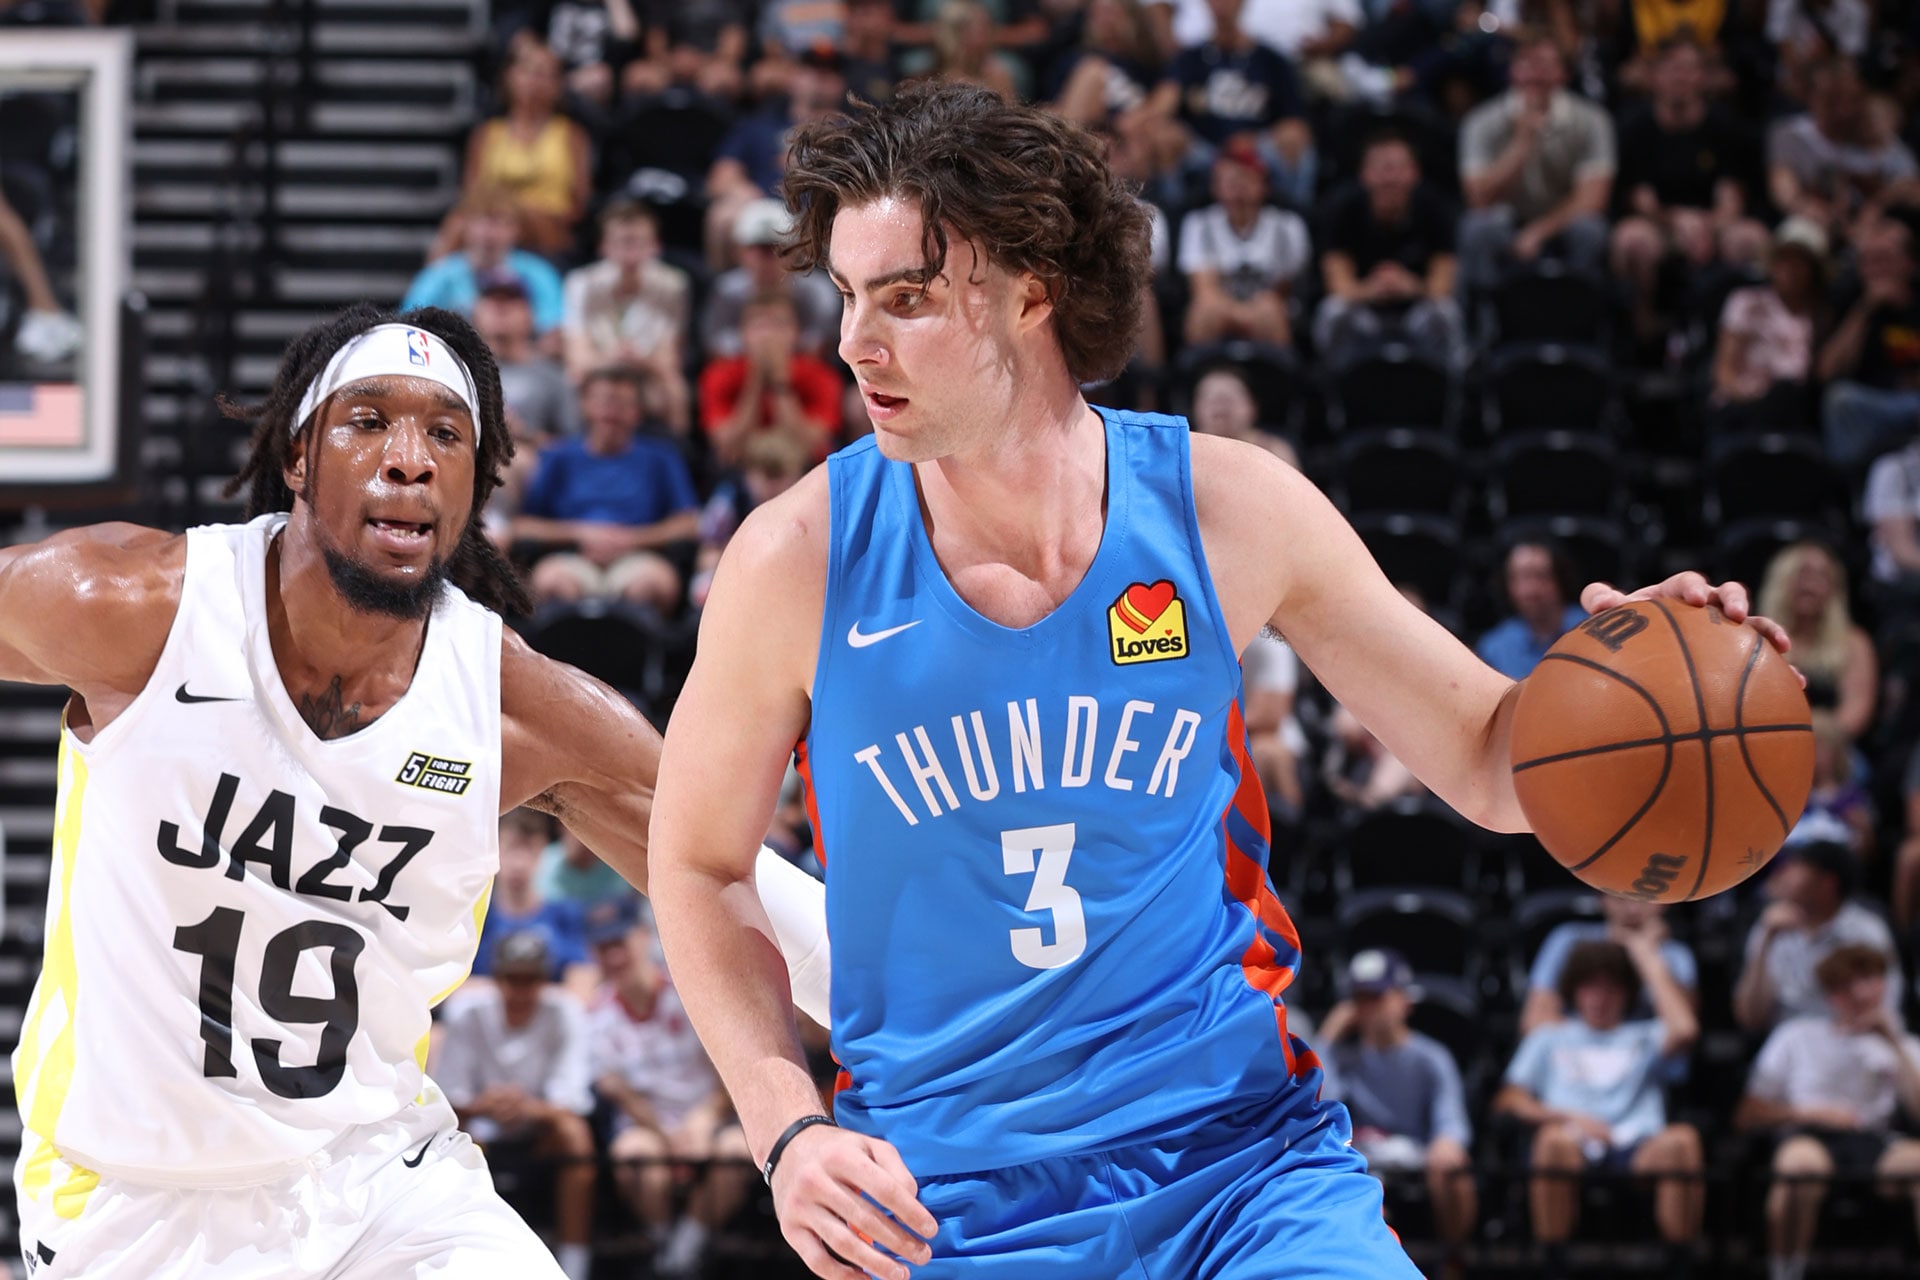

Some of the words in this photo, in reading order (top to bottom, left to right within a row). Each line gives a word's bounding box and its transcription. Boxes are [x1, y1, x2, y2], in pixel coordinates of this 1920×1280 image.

[401, 755, 426, 783] 5
[431, 760, 449, 771] FOR
[449, 763, 467, 774] THE
[421, 773, 467, 793] FIGHT
[853, 695, 1202, 826] THUNDER
[157, 772, 435, 922] JAZZ
[1000, 822, 1088, 970] 3
[173, 906, 366, 1099] 19
